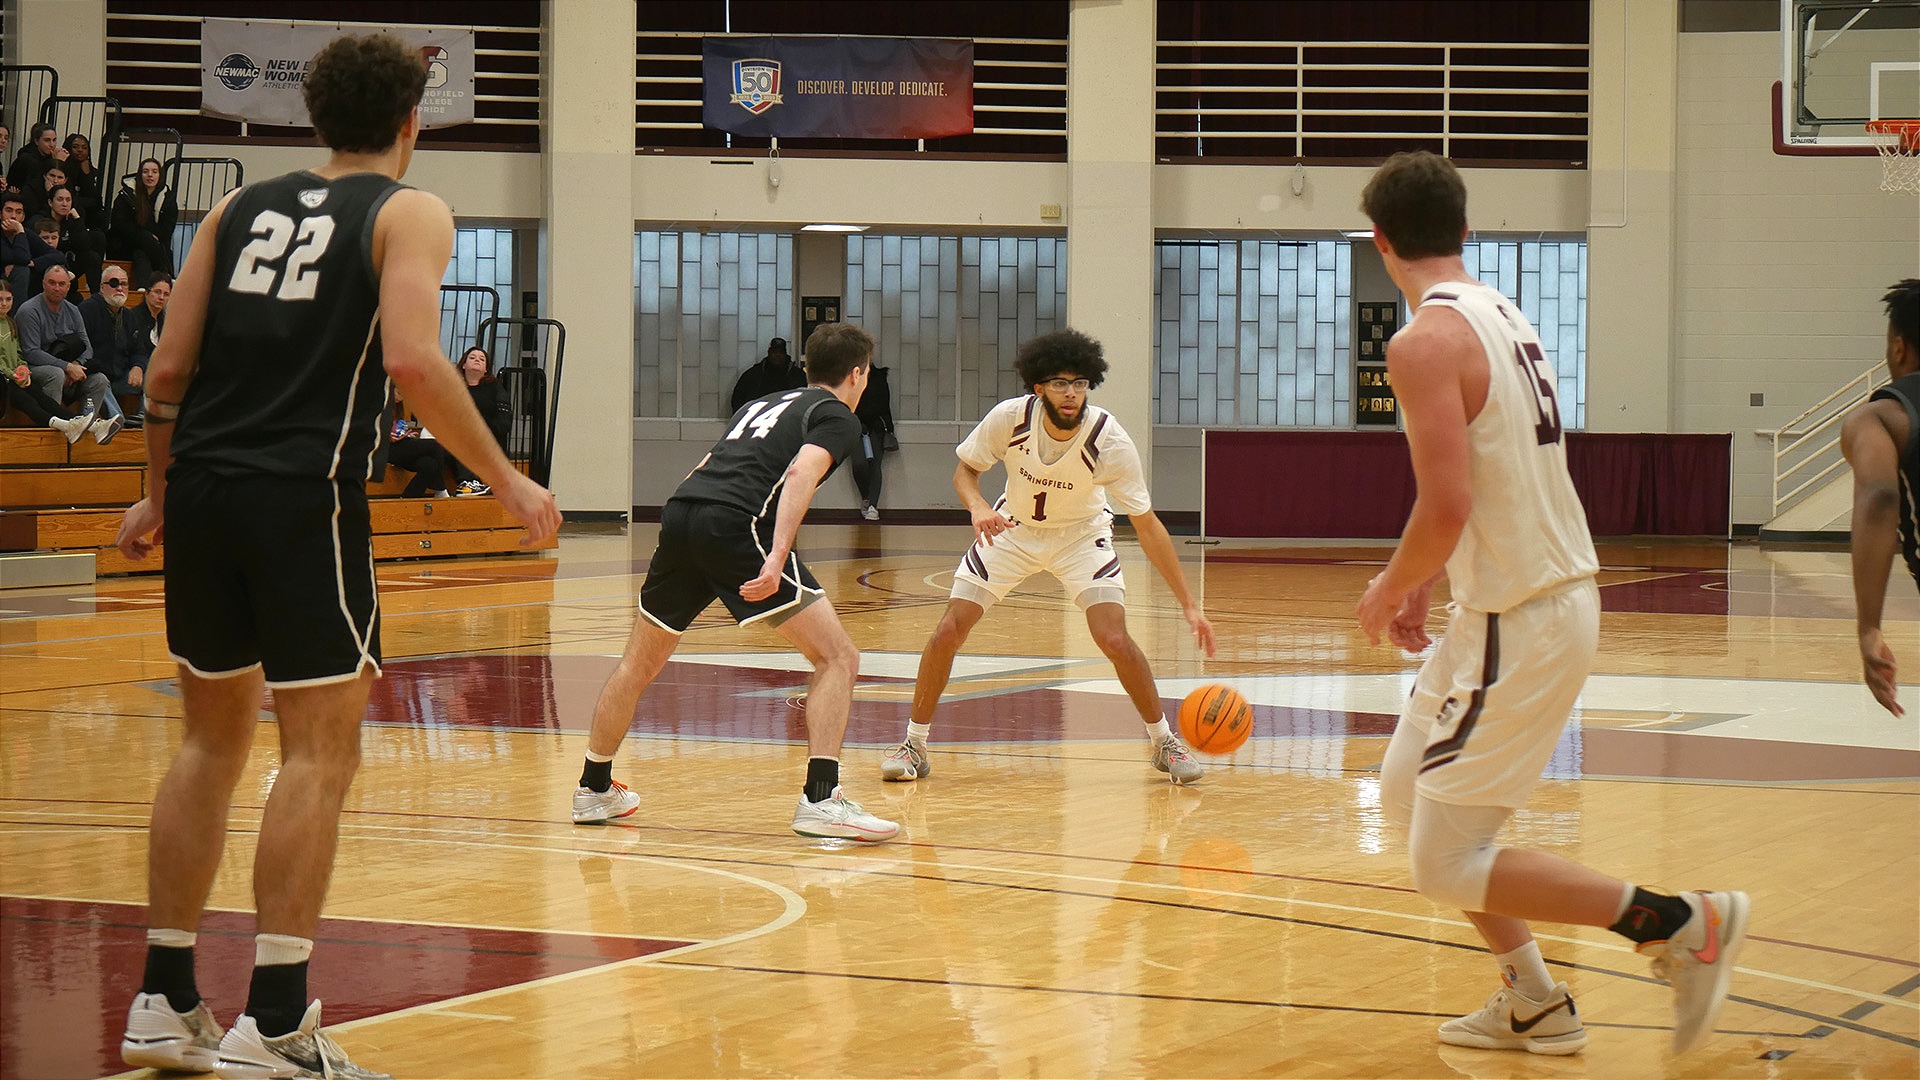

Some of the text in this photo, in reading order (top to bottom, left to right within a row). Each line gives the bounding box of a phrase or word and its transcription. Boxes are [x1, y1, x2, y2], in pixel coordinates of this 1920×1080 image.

[214, 66, 259, 78] NEWMAC
[266, 59, 300, 71] NEW
[262, 82, 299, 90] ATHLETIC
[264, 71, 308, 82] WOME
[742, 71, 772, 93] 50
[797, 79, 948, 97] DISCOVER. DEVELOP. DEDICATE.
[228, 210, 336, 302] 22
[1513, 340, 1562, 446] 15
[725, 400, 794, 440] 14
[1018, 467, 1074, 491] SPRINGFIELD
[1031, 491, 1048, 522] 1
